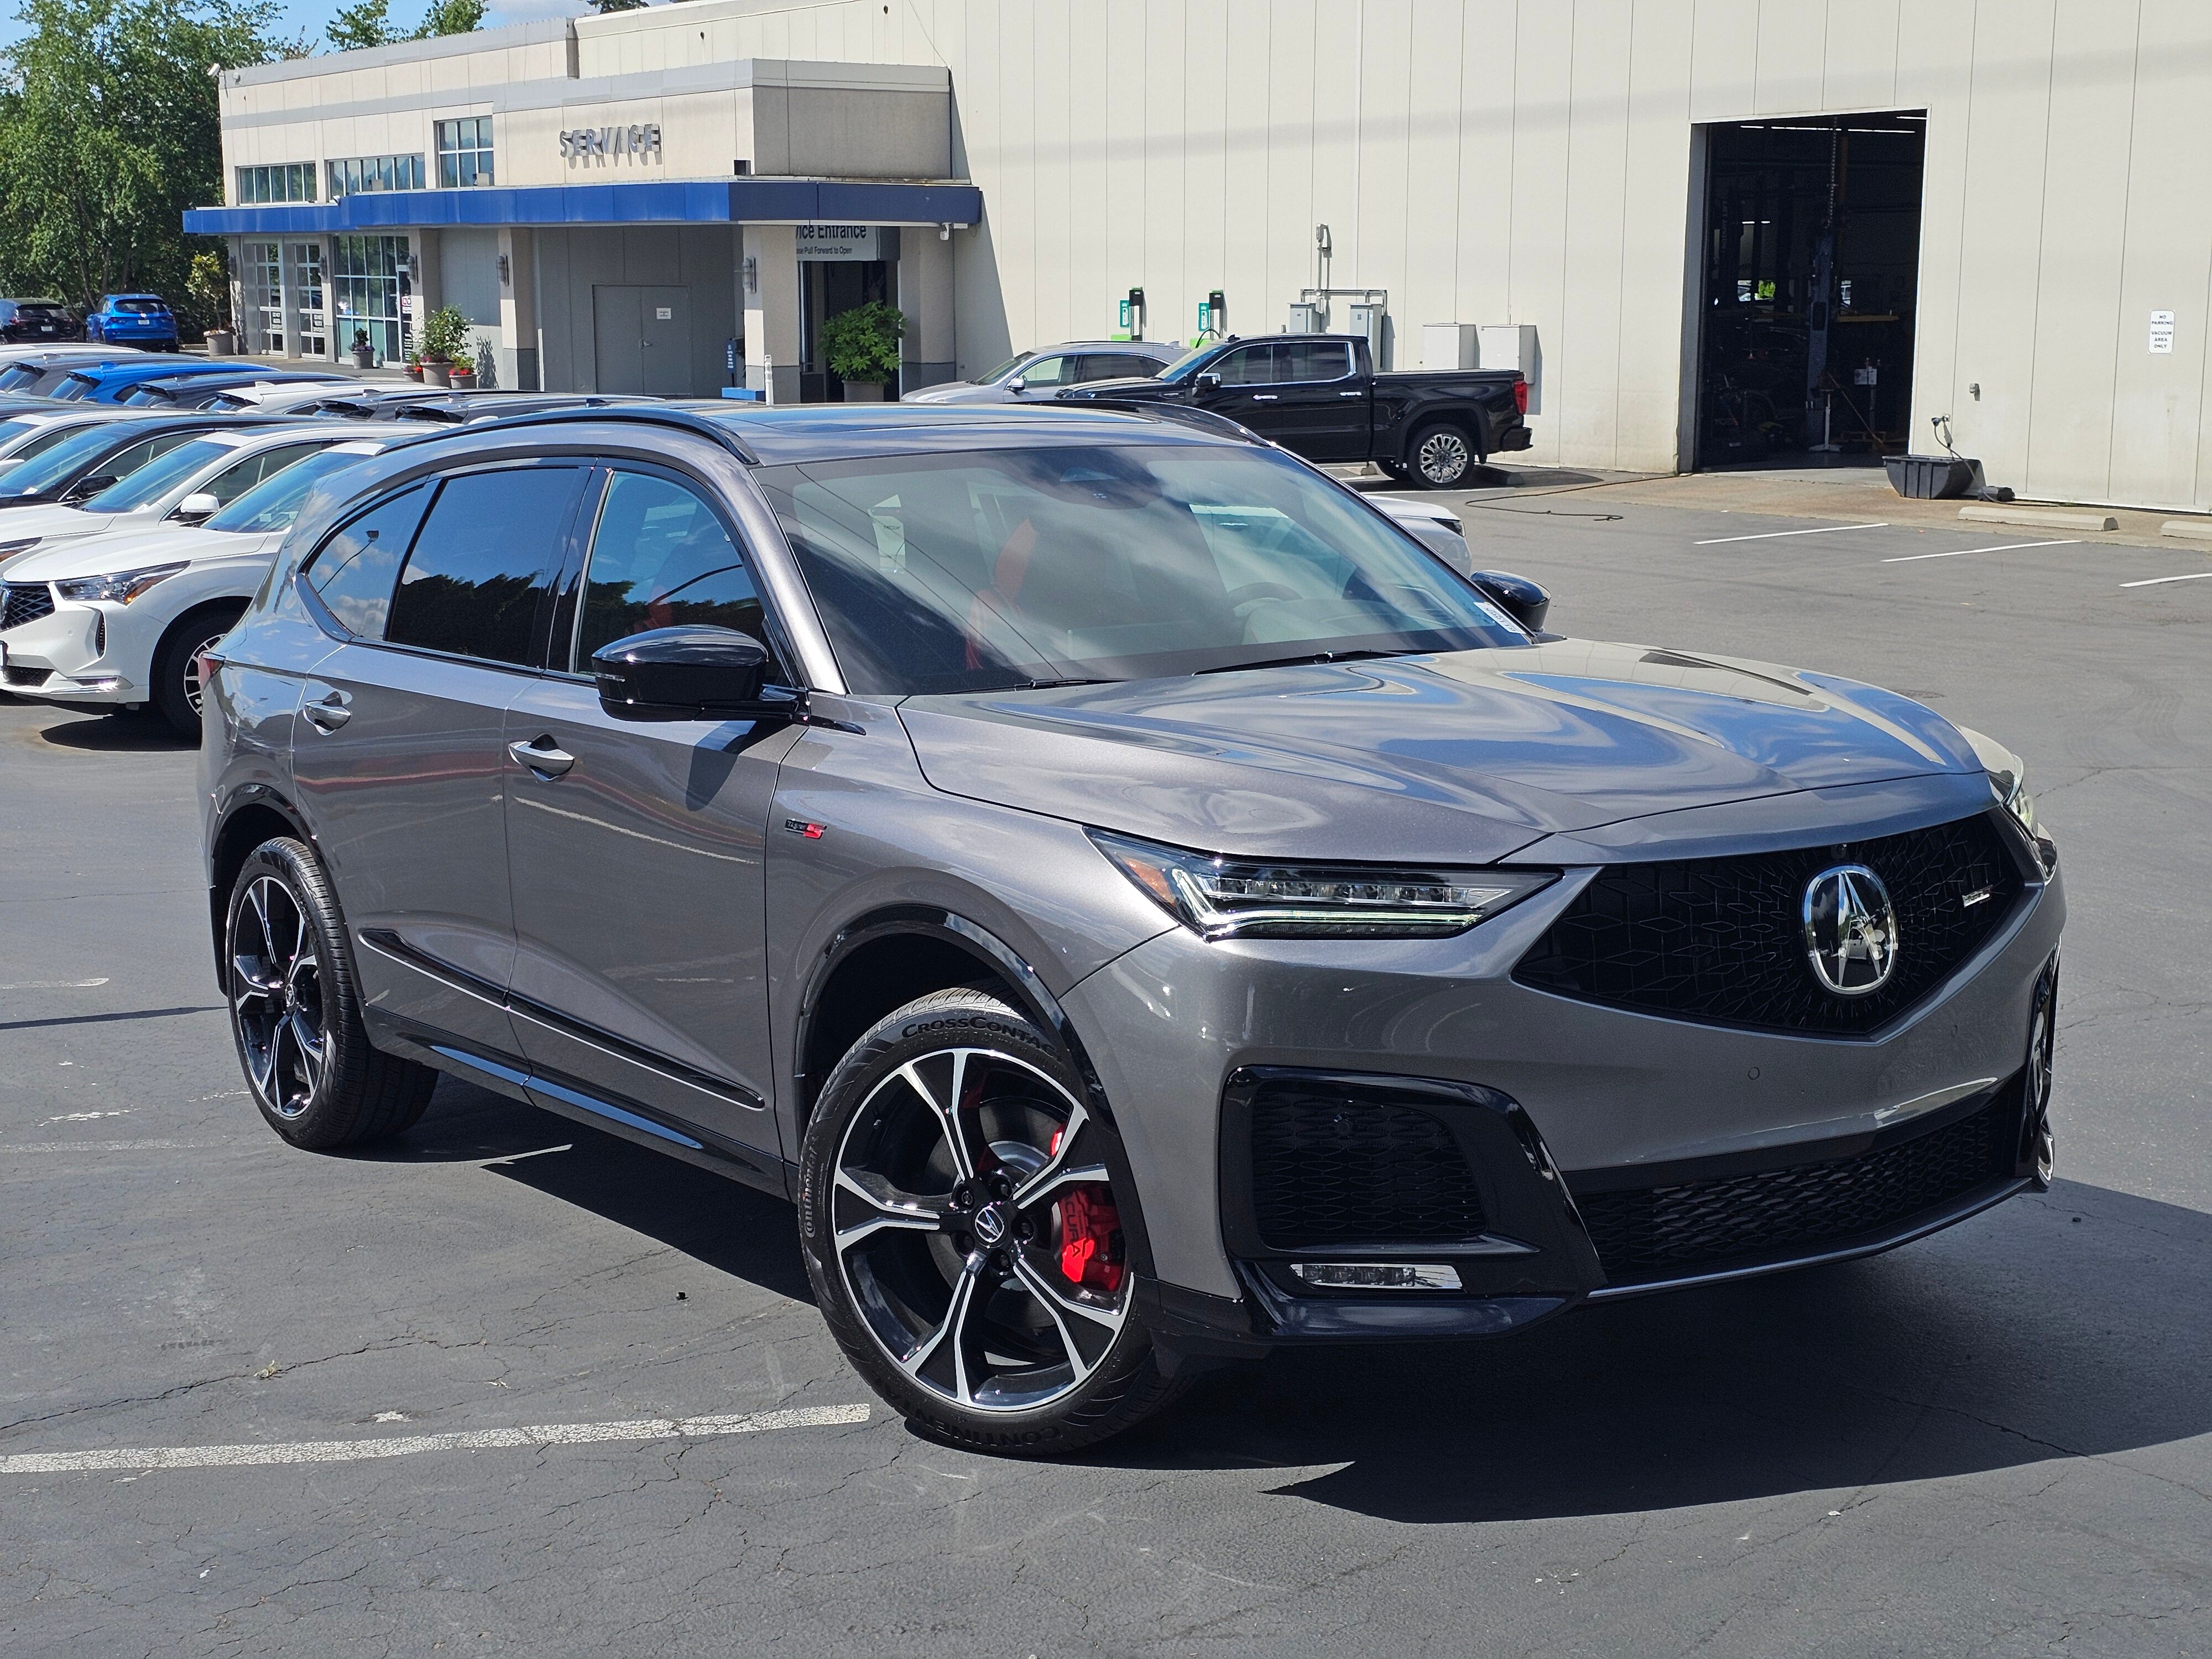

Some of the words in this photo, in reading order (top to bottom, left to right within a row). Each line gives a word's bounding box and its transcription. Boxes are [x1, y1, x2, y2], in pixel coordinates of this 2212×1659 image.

[559, 123, 661, 158] SERVICE
[818, 225, 867, 239] Entrance
[815, 246, 833, 254] Forward
[839, 246, 852, 255] Open
[902, 1016, 1060, 1058] CROSSCONTAC
[805, 1146, 818, 1238] Continental
